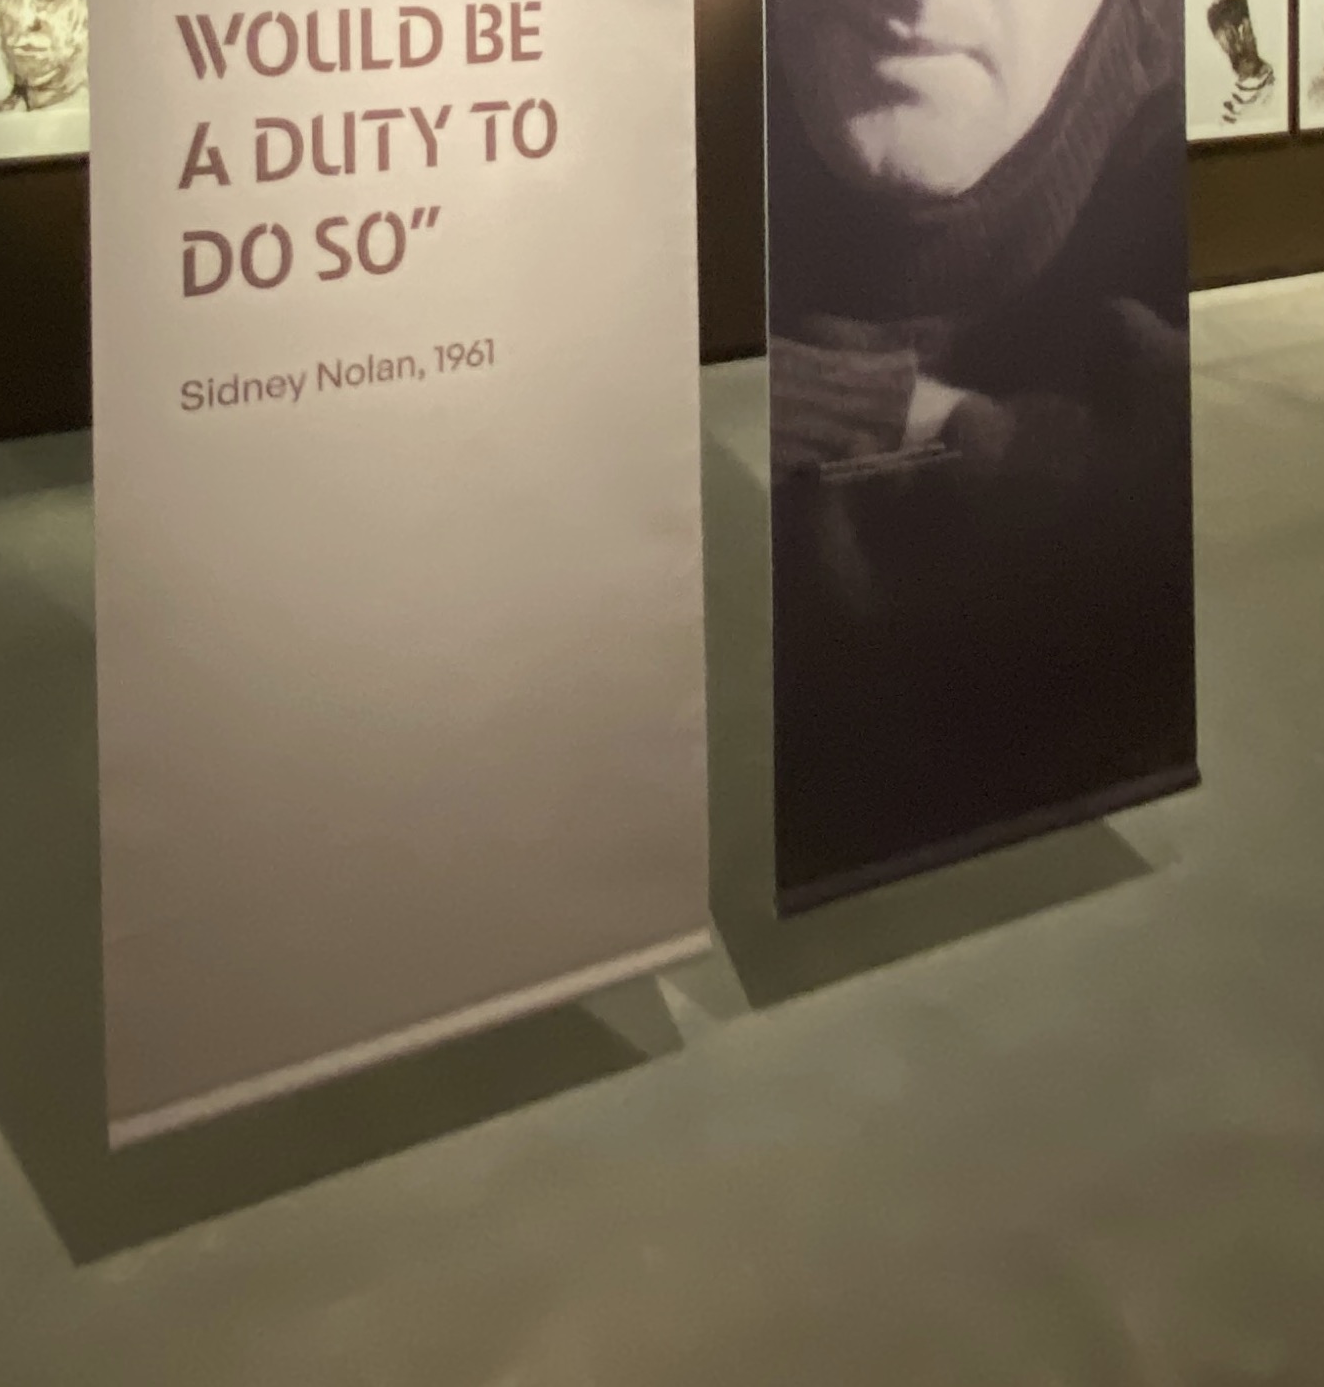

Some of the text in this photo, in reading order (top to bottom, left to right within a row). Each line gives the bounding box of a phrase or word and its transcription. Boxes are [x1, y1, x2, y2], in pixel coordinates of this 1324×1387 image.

[175, 1, 543, 80] WOULD BE
[178, 98, 558, 190] A DUTY TO
[181, 223, 293, 297] DO
[180, 339, 495, 411] Sidney Nolan, 1961
